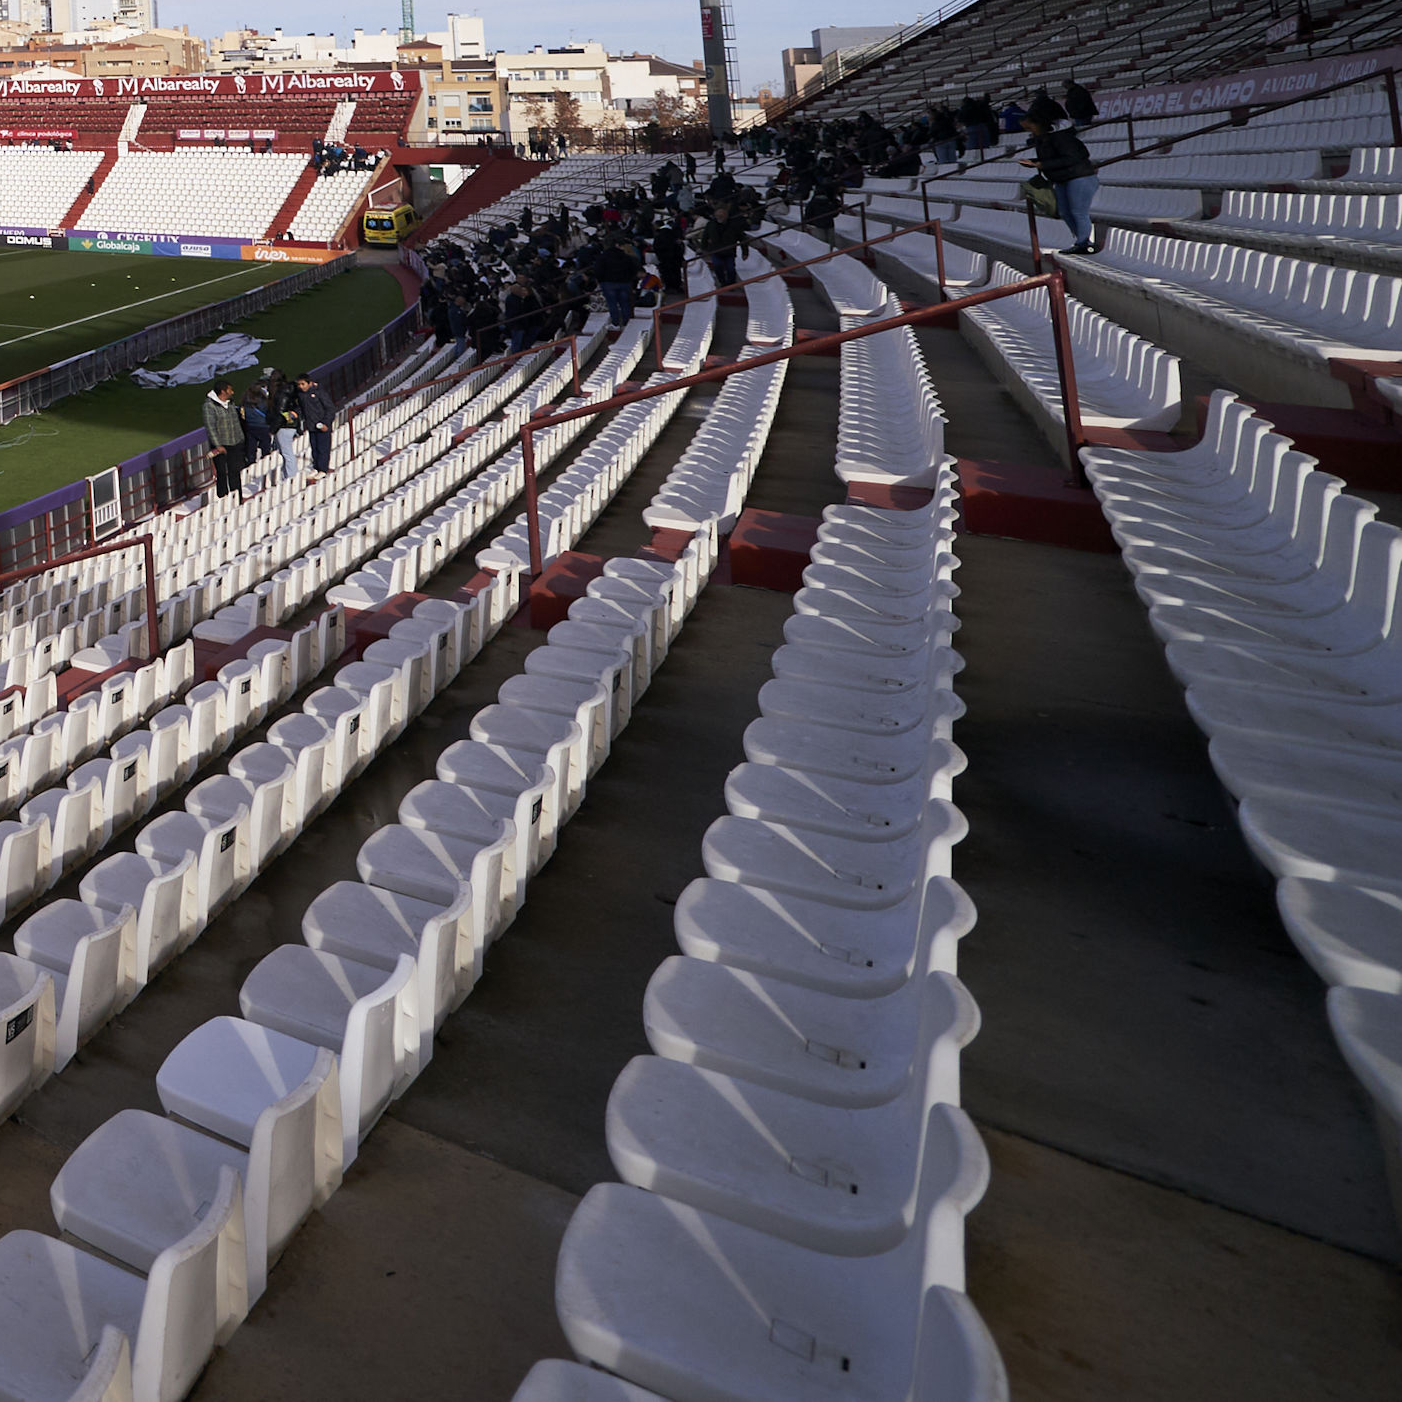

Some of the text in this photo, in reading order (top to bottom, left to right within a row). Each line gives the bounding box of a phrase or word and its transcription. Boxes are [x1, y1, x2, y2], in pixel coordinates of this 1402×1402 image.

[9, 79, 81, 96] Albarealty
[117, 76, 220, 95] JVJ Albarealty
[260, 73, 376, 94] JVJ Albarealty
[1096, 94, 1131, 119] SIÓN
[1189, 80, 1256, 110] CAMPO
[6, 235, 53, 246] DOMUS
[96, 239, 140, 254] Globalcaja
